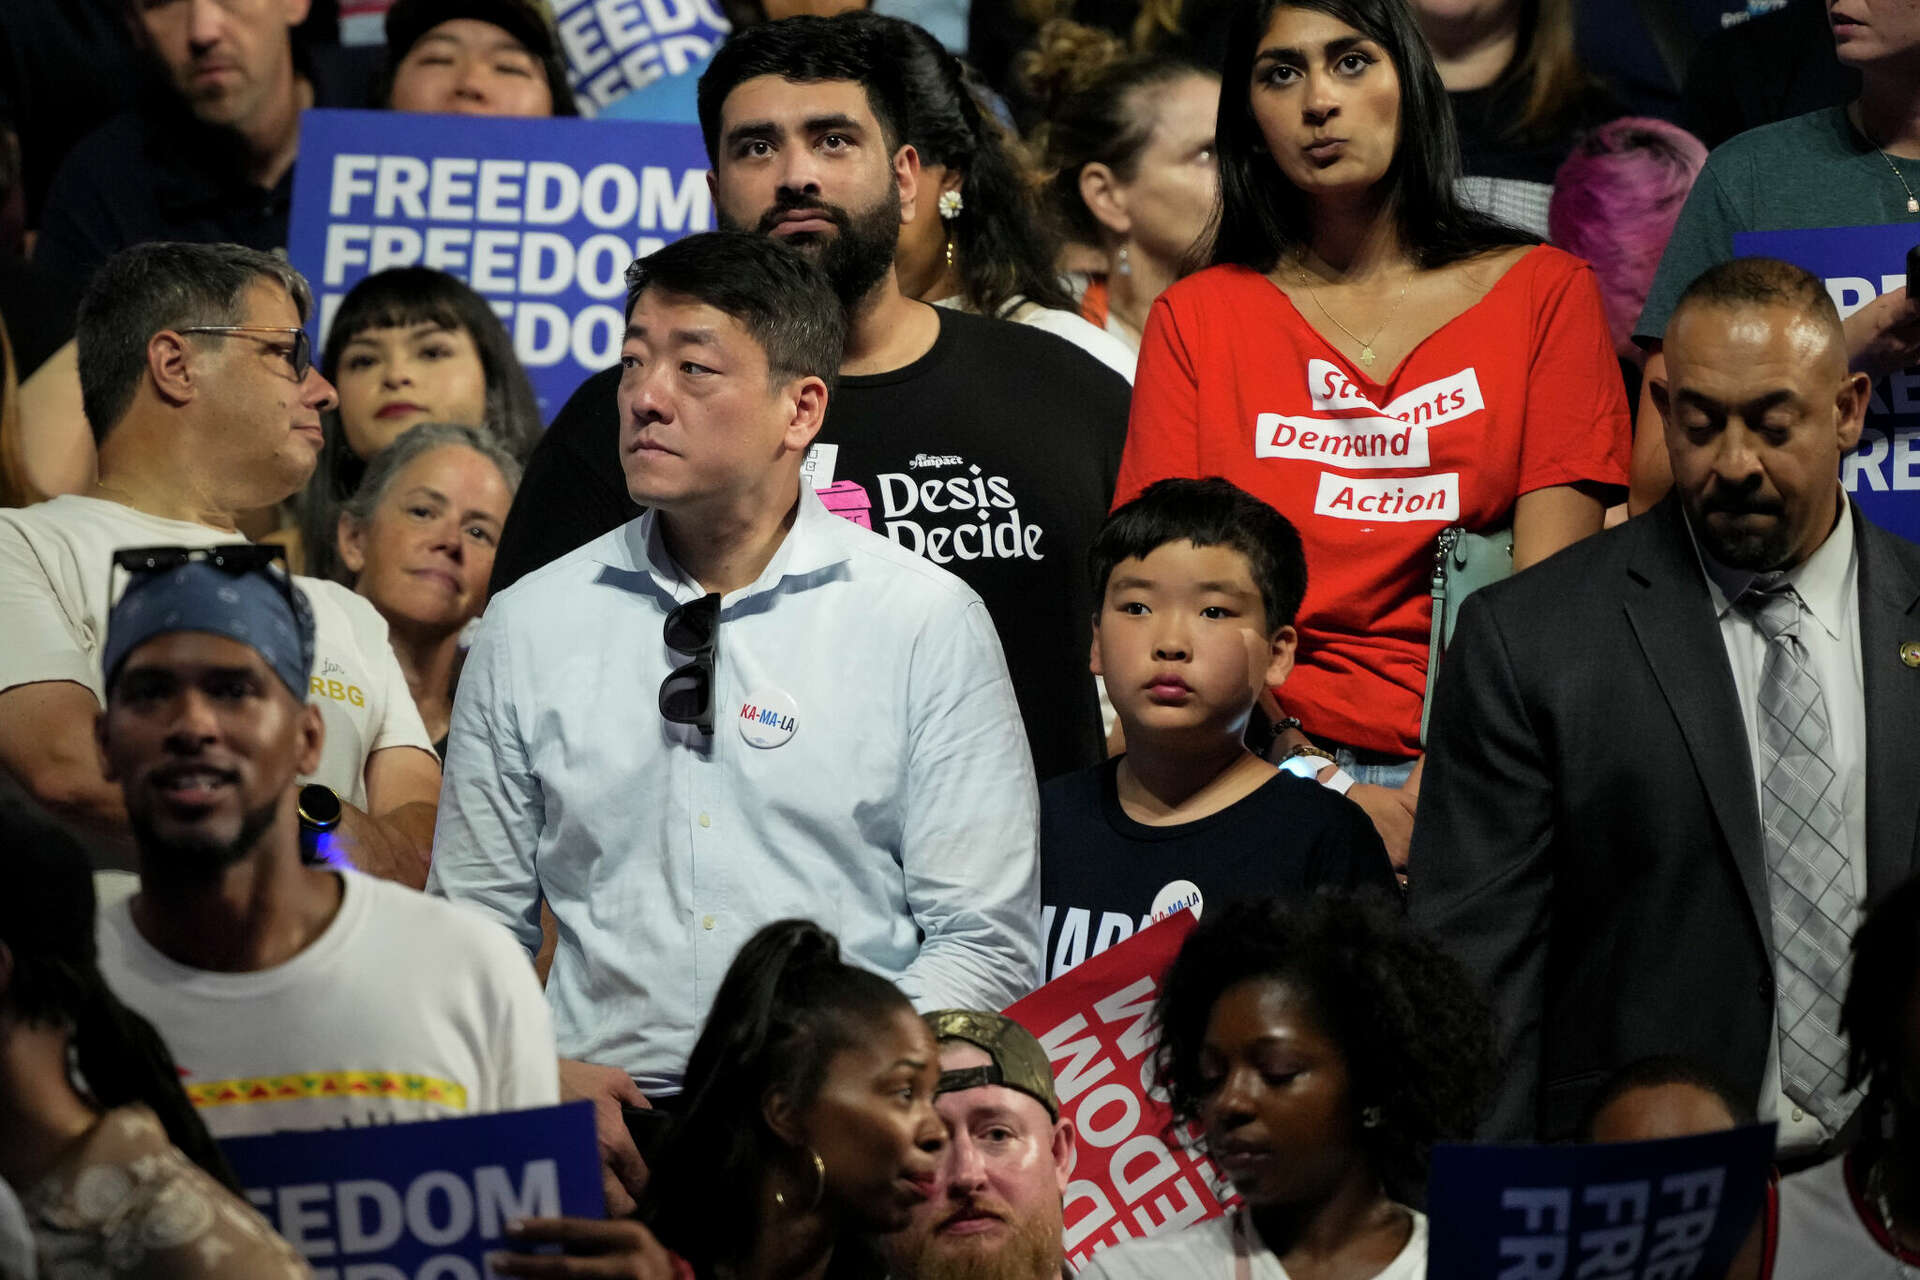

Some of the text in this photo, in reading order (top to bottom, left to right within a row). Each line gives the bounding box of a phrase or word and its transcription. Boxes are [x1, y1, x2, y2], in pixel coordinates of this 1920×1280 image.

[329, 153, 711, 231] FREEDOM
[322, 223, 667, 299] FREEDO
[1270, 423, 1412, 457] Demand
[876, 464, 1016, 518] Desis
[1329, 486, 1447, 515] Action
[884, 508, 1045, 564] Decide
[309, 676, 365, 709] RBG
[740, 703, 795, 733] KA-MA-LA
[246, 1158, 562, 1258] EDOM
